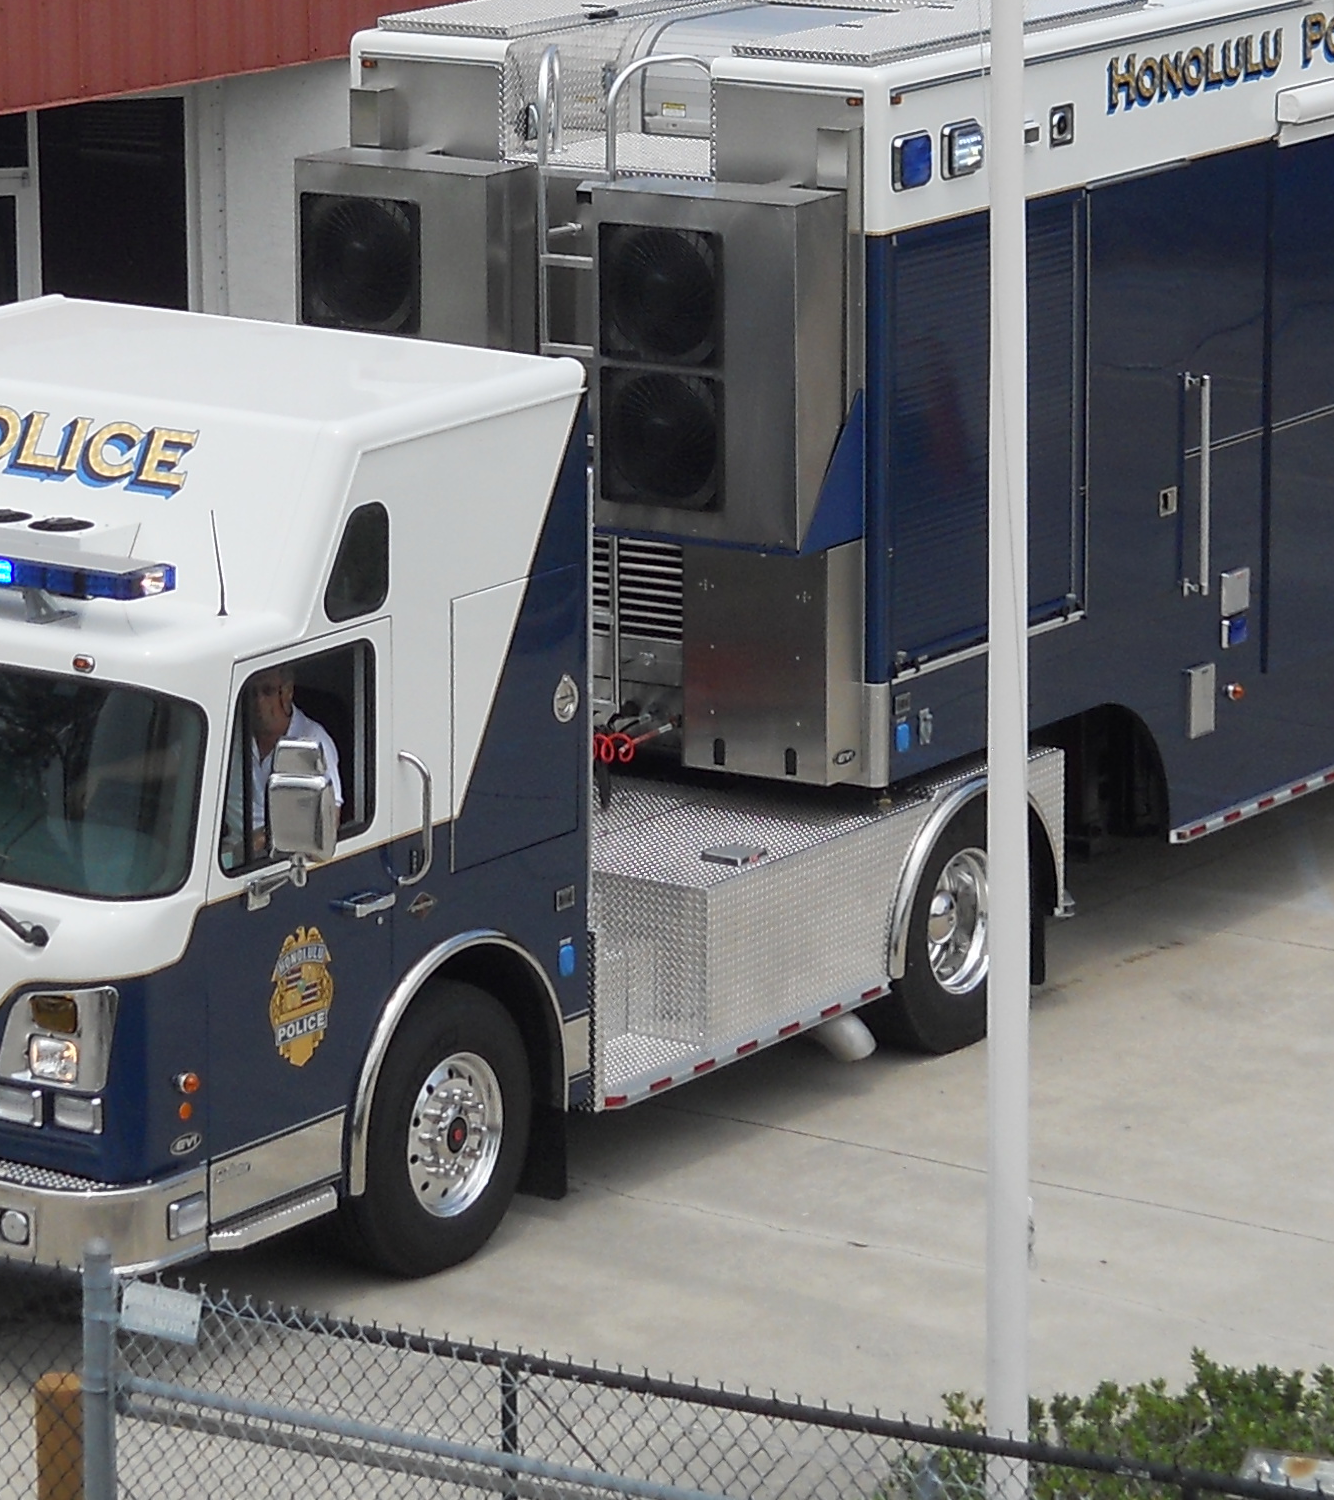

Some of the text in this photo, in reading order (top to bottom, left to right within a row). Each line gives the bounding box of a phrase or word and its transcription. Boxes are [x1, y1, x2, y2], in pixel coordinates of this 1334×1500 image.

[1106, 27, 1283, 115] HONOLULU
[277, 945, 325, 974] HONOLULU
[277, 1012, 325, 1042] POLICE
